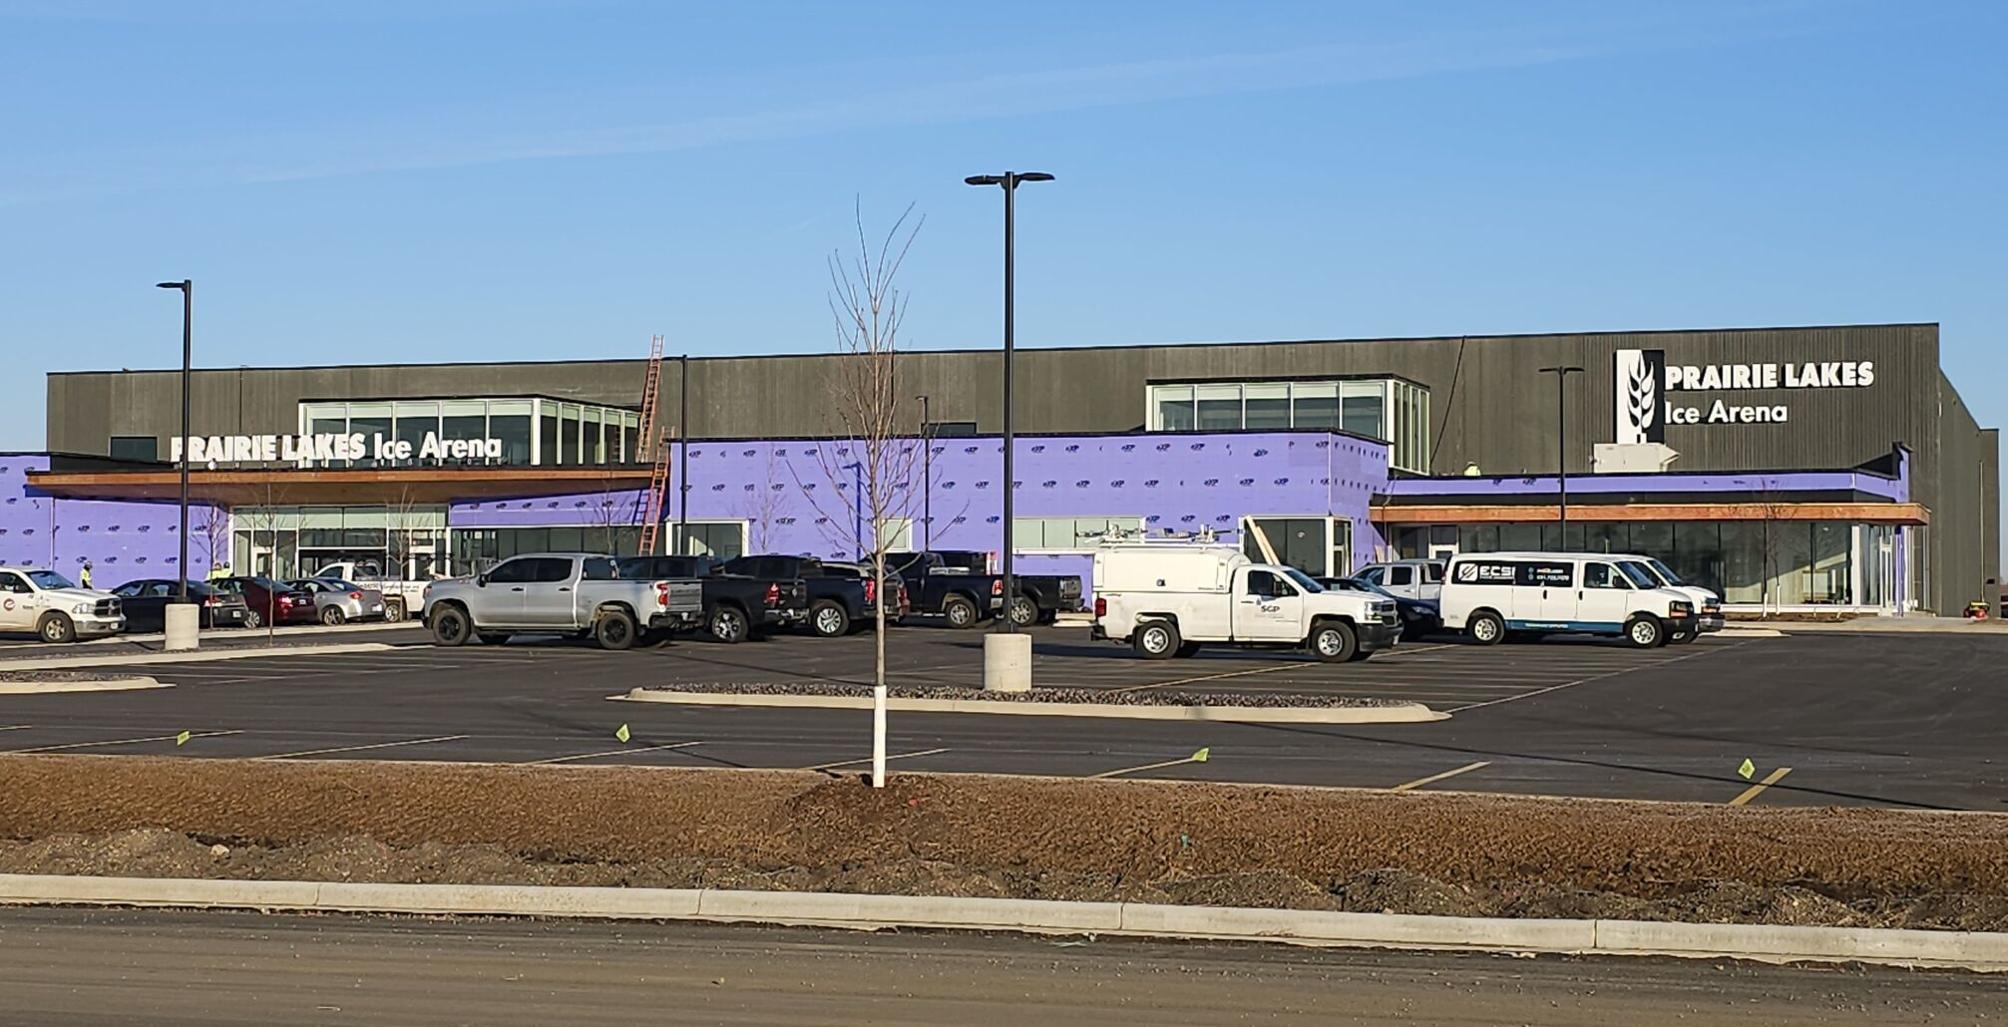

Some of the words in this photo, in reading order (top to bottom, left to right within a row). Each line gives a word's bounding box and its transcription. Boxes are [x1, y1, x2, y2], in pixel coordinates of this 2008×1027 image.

[1665, 364, 1778, 390] PRAIRIE
[1785, 362, 1874, 387] LAKES
[1665, 402, 1699, 424] Ice
[1708, 400, 1787, 423] Arena
[171, 435, 277, 462] PRAIRIE
[282, 433, 365, 461] LAKES
[374, 432, 412, 460] Ice
[419, 431, 502, 459] Arena
[1480, 565, 1516, 577] ECSI
